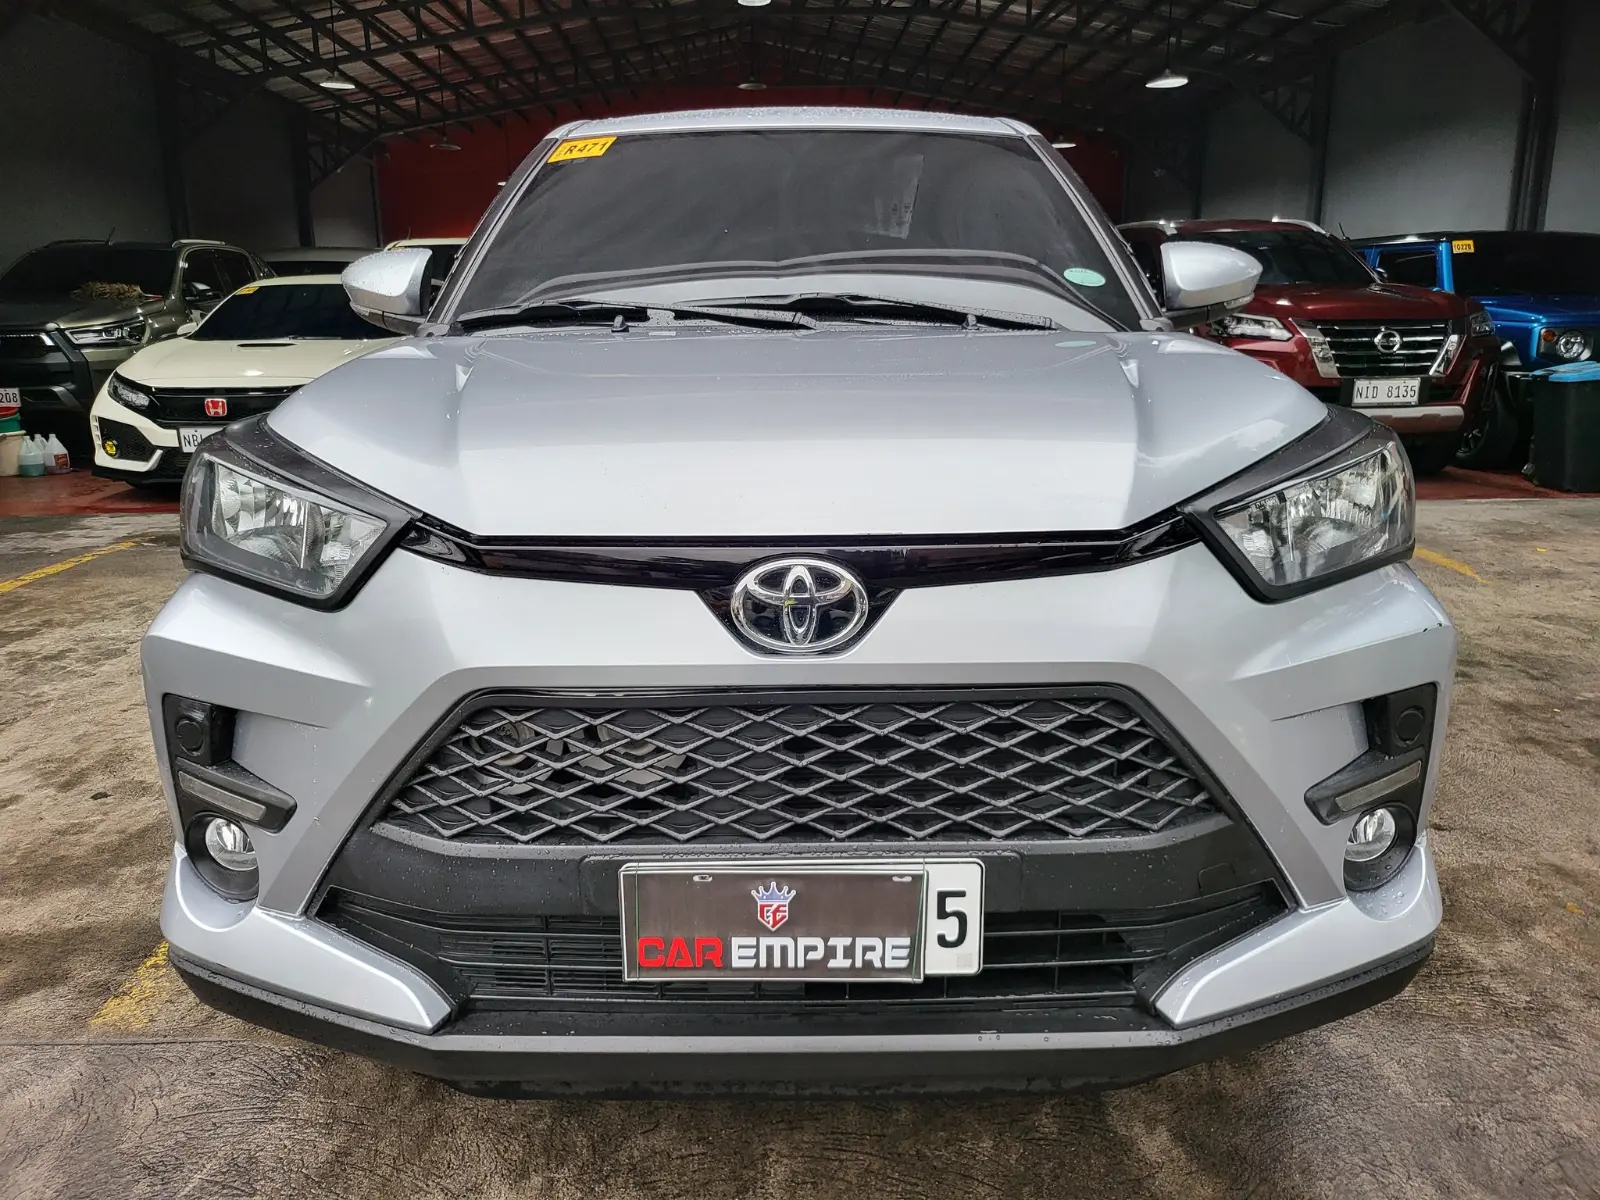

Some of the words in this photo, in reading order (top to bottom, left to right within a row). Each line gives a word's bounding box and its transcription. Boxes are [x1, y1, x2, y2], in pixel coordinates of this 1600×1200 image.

[564, 142, 609, 156] R471
[1355, 386, 1379, 399] NID
[1386, 385, 1417, 399] 8135
[183, 434, 203, 447] NB
[936, 889, 968, 948] 5
[637, 936, 723, 968] CAR
[731, 936, 911, 968] EMPIRE
